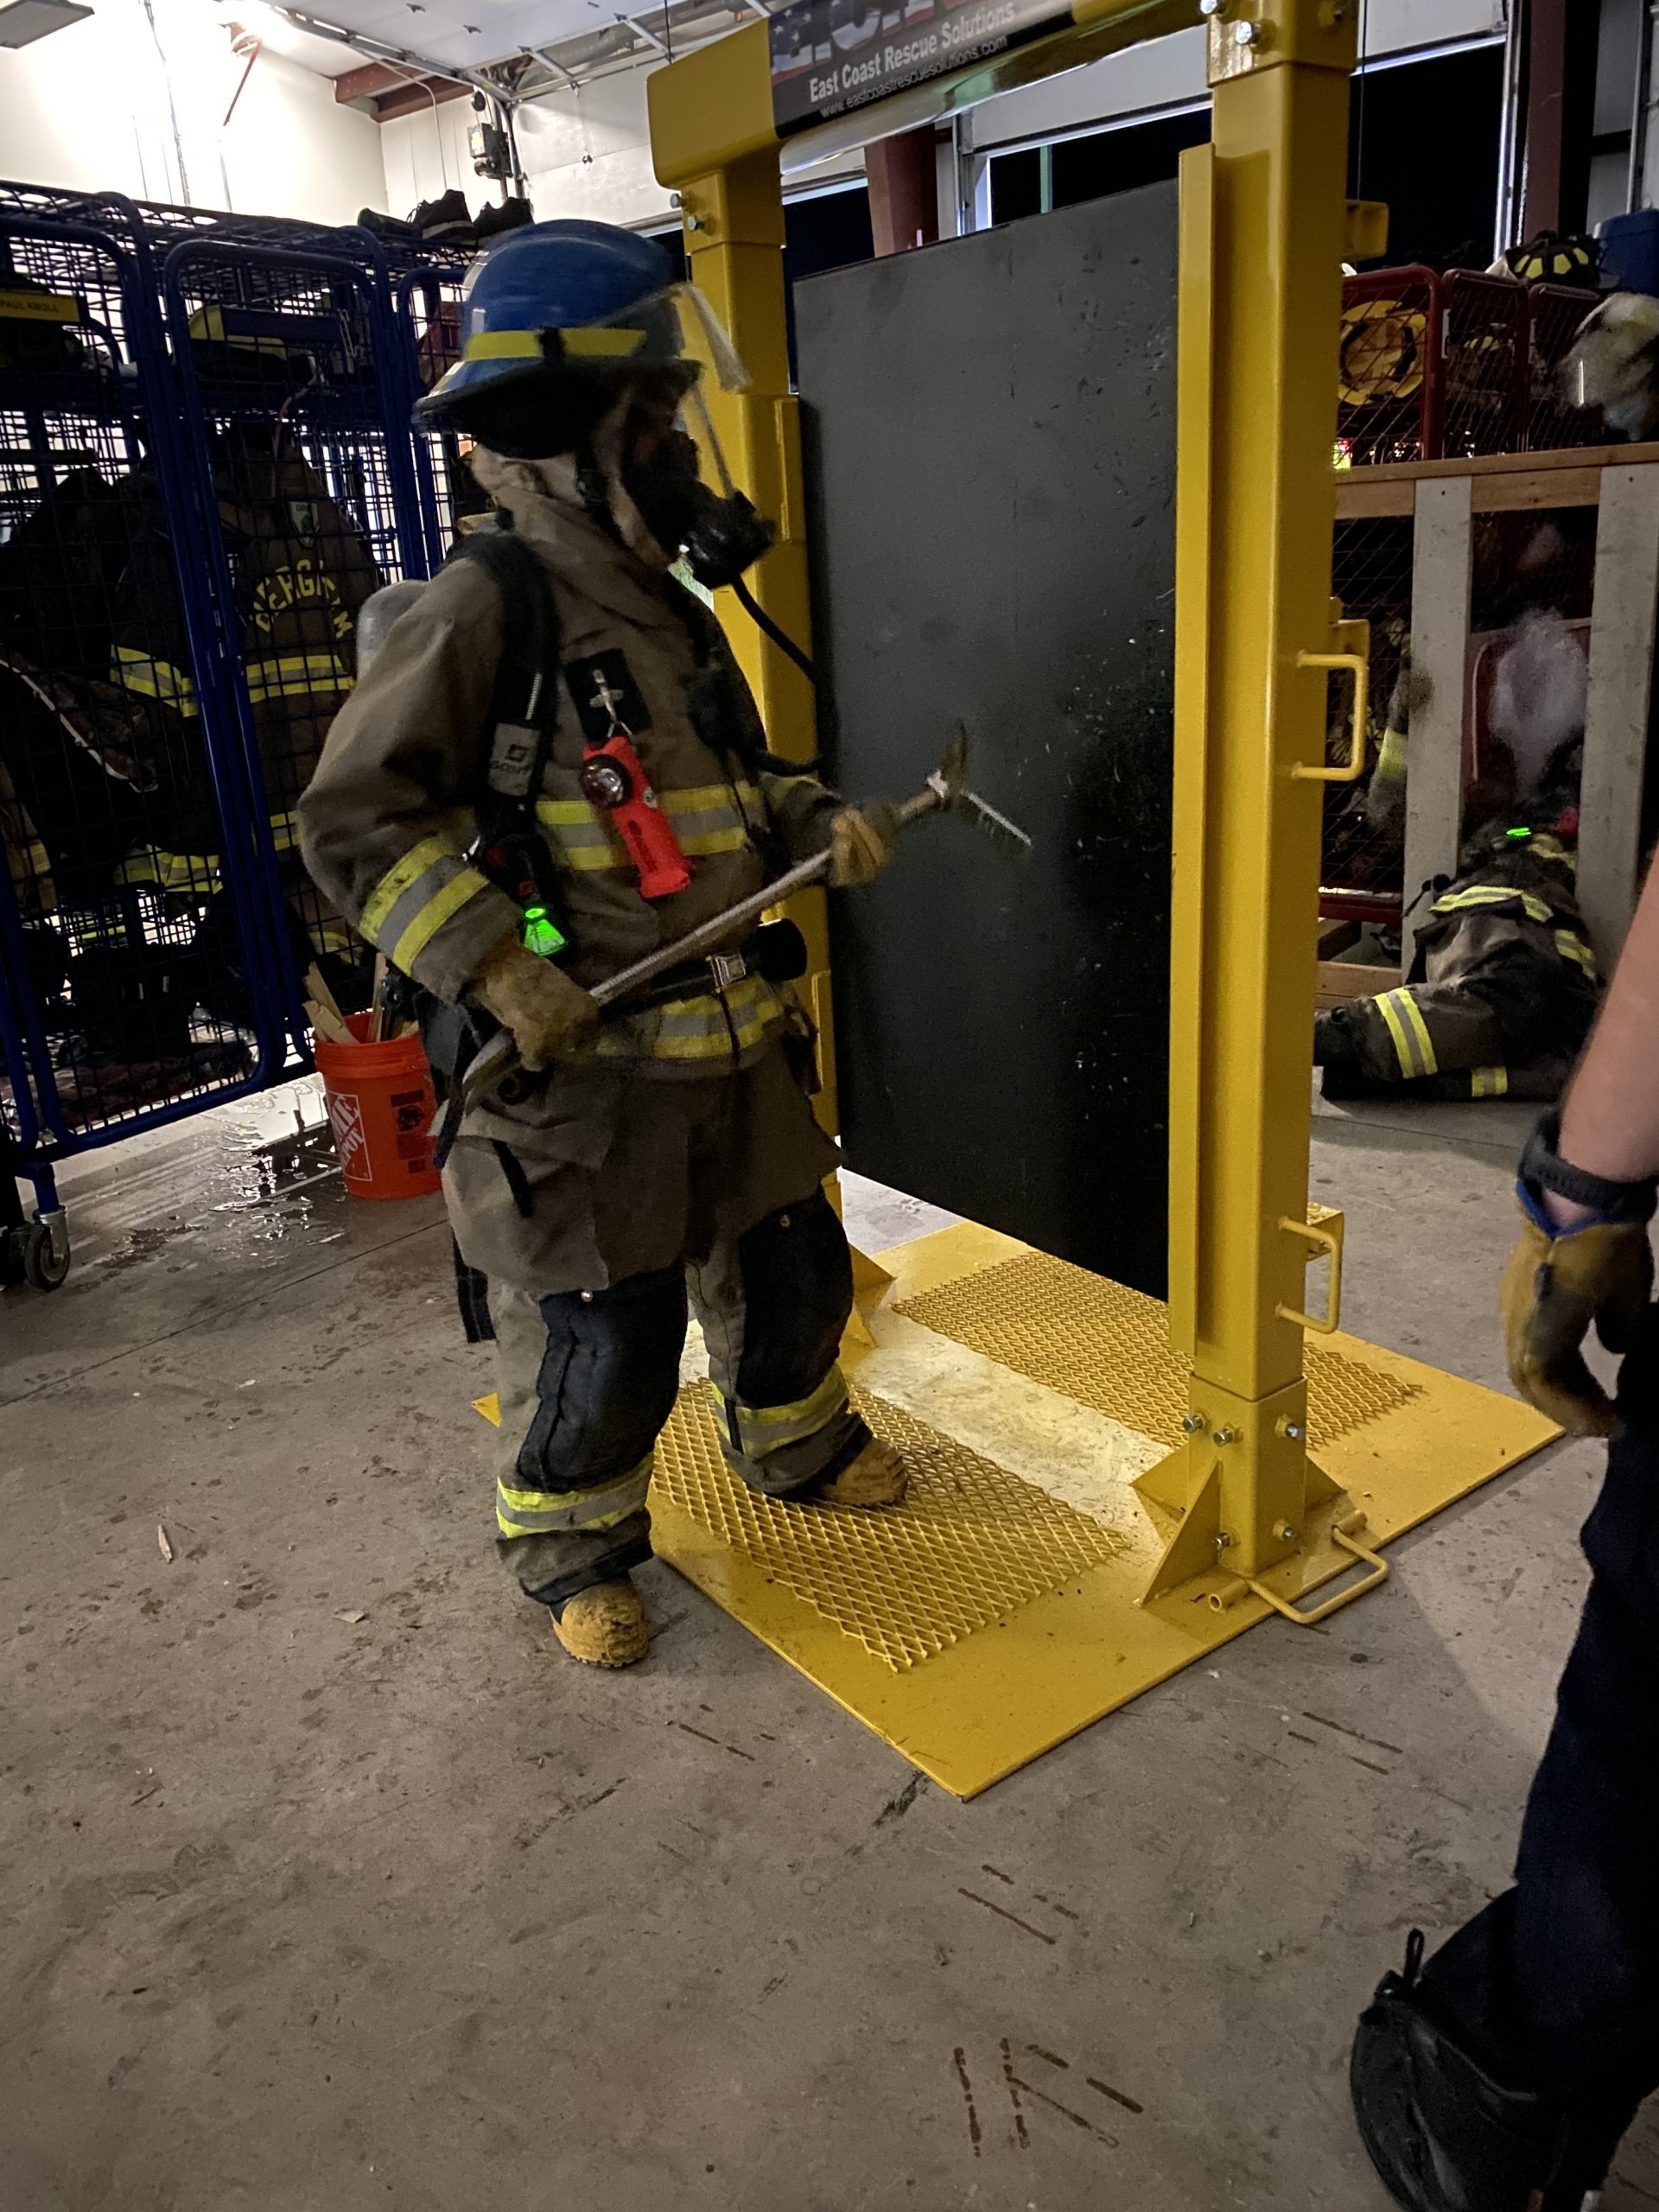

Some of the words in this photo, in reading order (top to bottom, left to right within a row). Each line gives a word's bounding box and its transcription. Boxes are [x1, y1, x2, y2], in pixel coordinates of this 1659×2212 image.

[810, 73, 839, 103] East
[842, 60, 881, 90] Coast
[884, 39, 938, 72] Rescue
[941, 2, 1015, 48] Solutions
